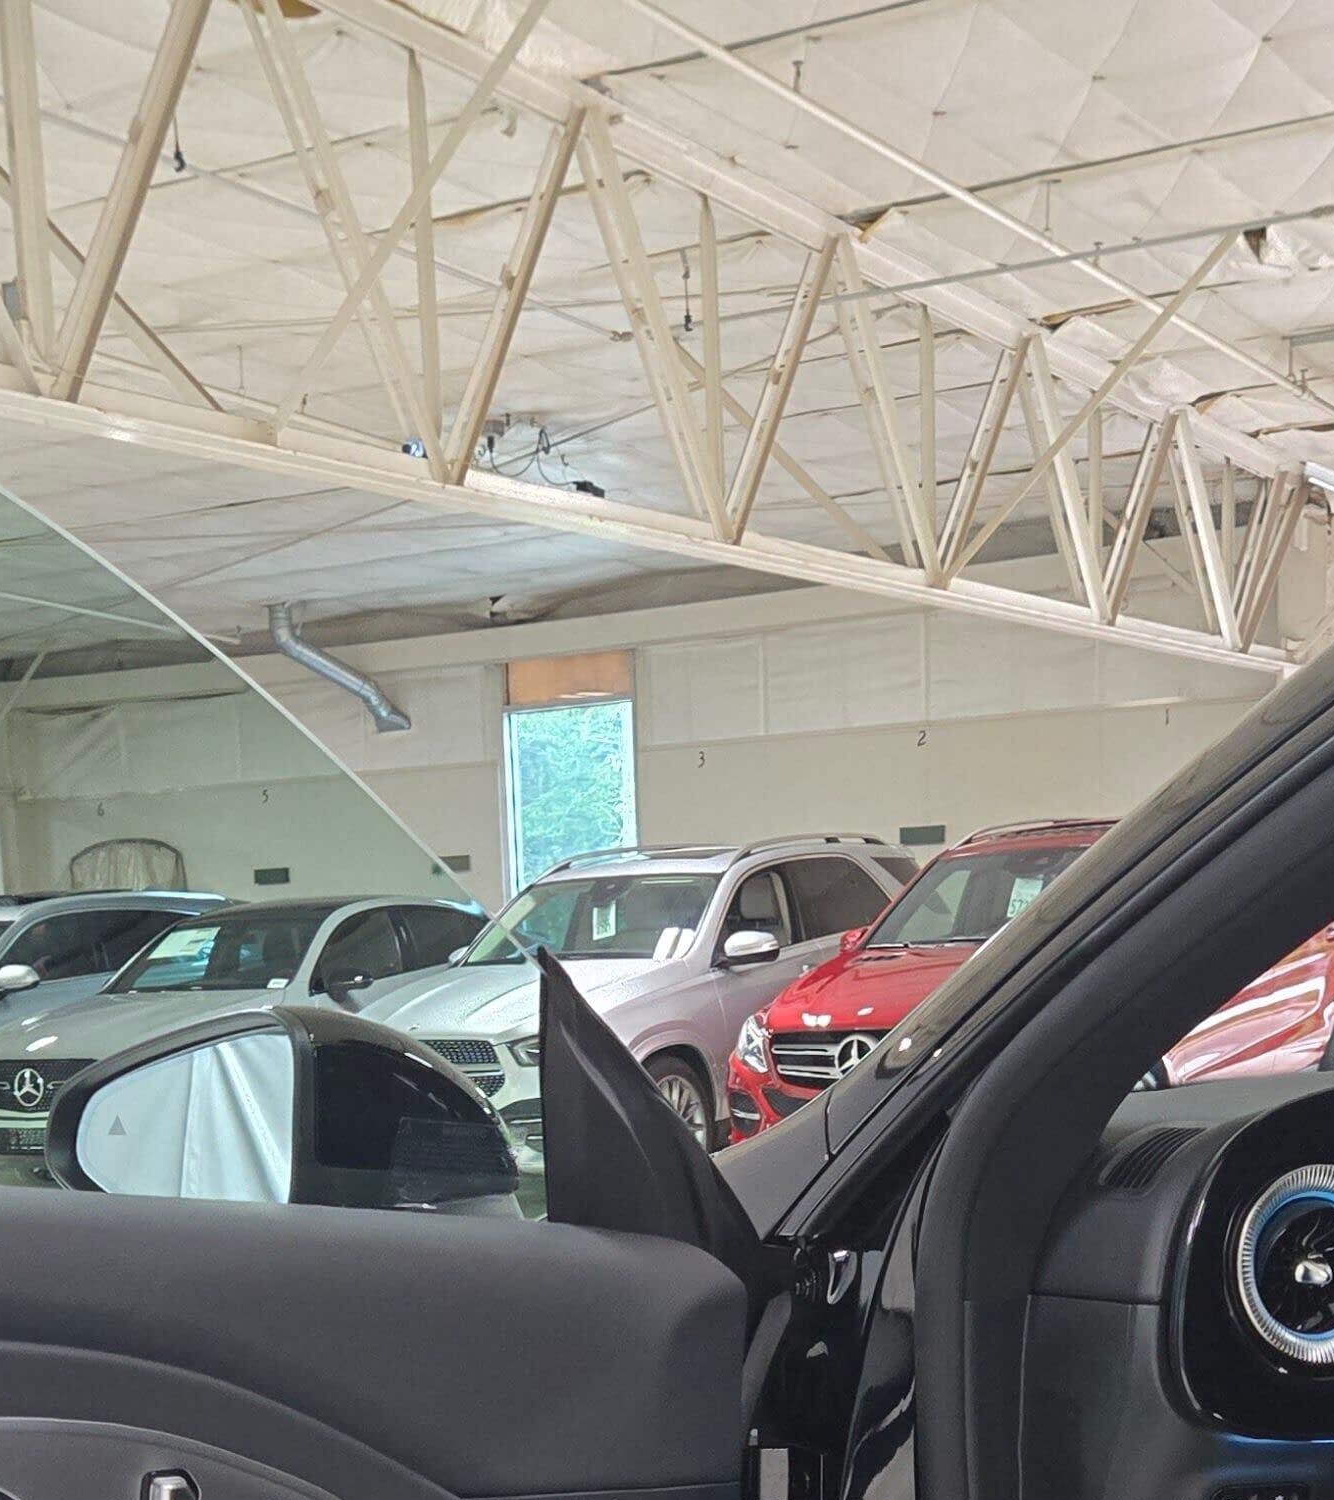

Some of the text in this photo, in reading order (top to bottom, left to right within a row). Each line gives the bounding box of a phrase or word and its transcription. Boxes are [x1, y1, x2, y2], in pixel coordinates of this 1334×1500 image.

[917, 730, 927, 747] 2
[698, 751, 705, 768] 3
[262, 789, 269, 804] 5
[97, 801, 105, 816] 6
